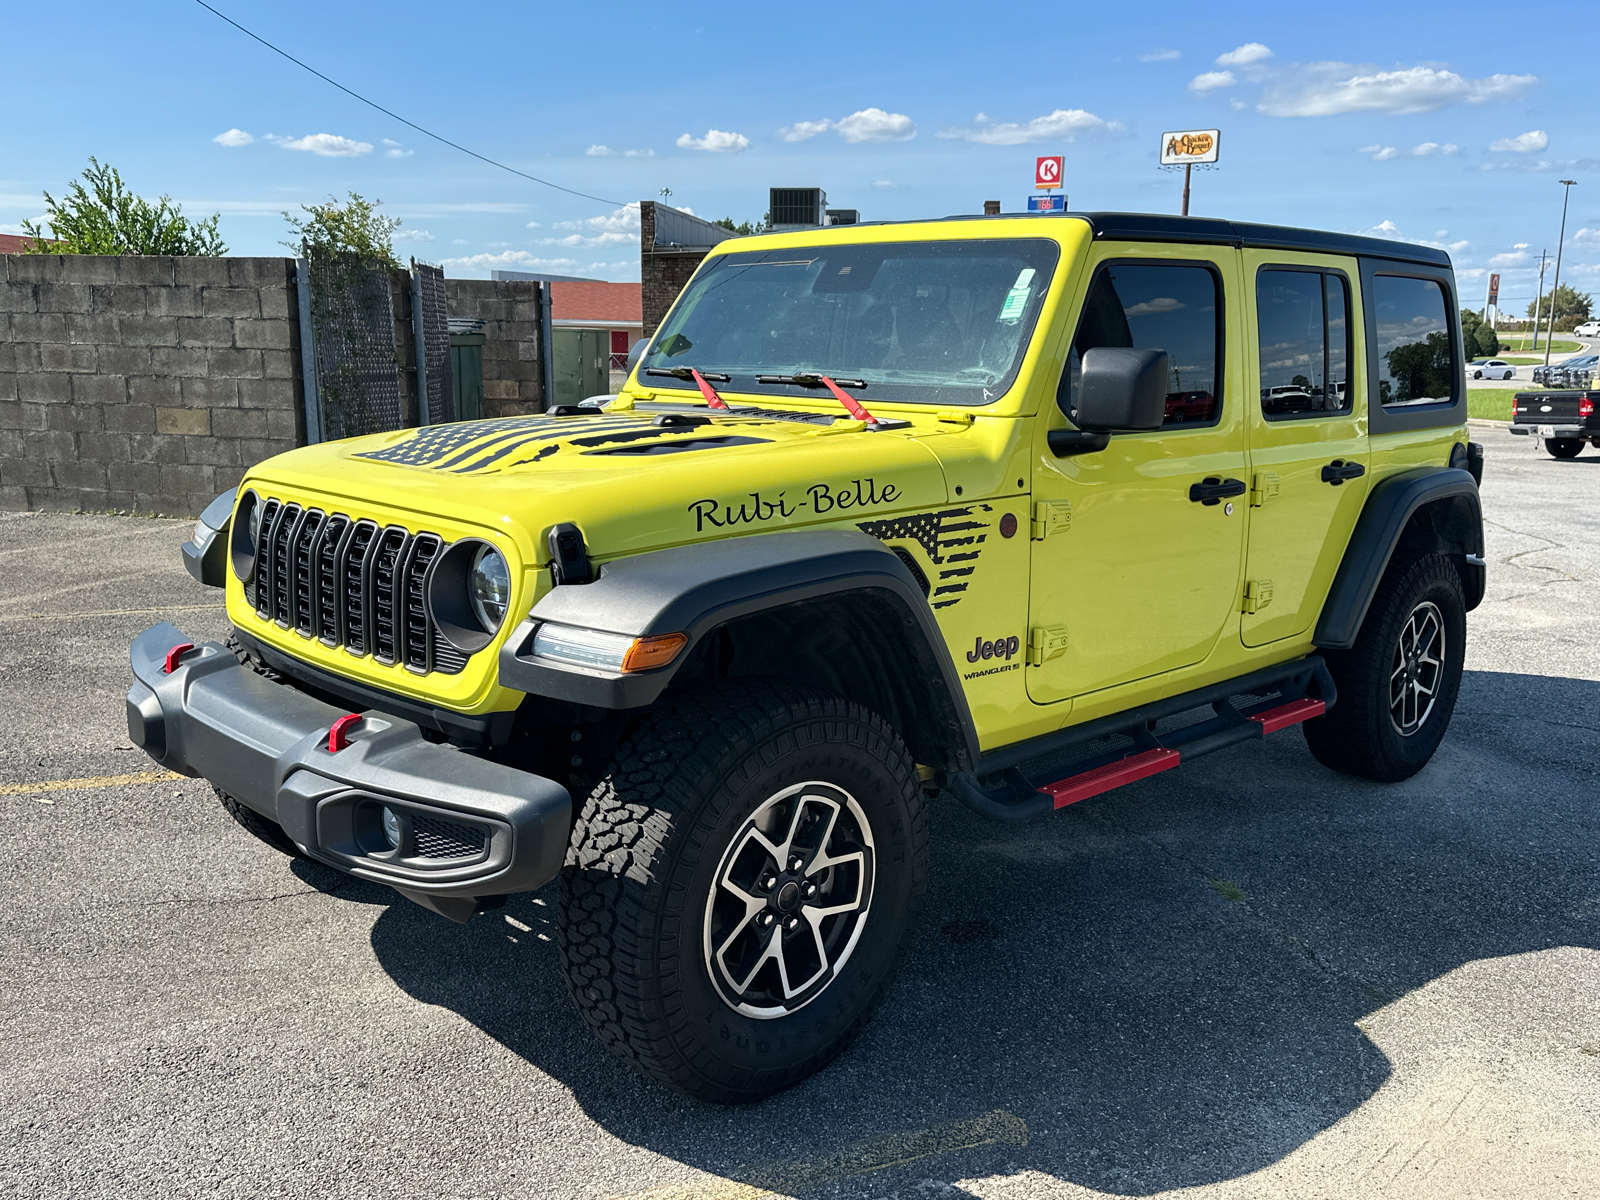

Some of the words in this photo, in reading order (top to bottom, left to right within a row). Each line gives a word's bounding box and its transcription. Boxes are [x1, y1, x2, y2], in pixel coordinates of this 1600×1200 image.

[1044, 163, 1055, 177] K
[688, 477, 903, 532] Rubi-Belle
[966, 635, 1020, 663] Jeep
[964, 665, 1012, 680] WRANGLER
